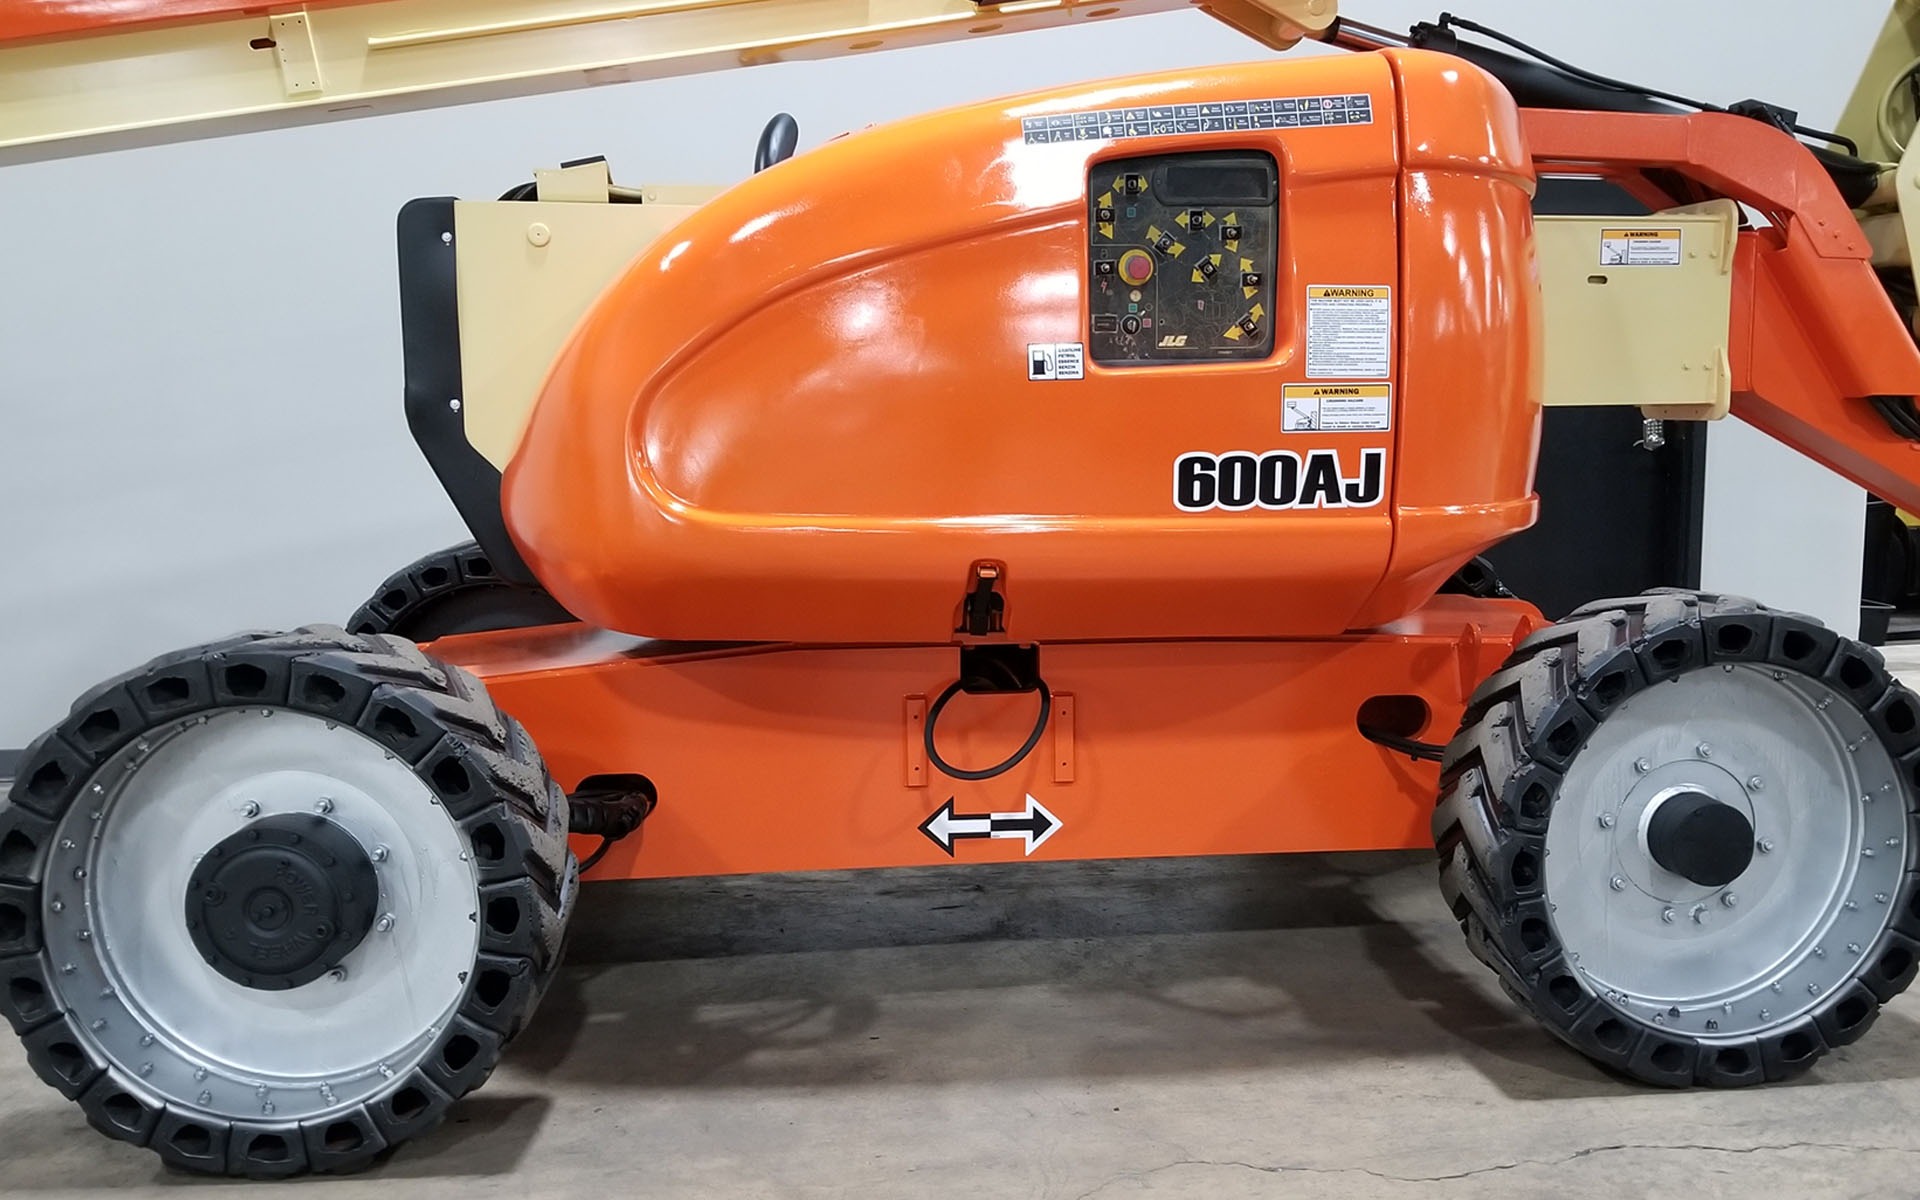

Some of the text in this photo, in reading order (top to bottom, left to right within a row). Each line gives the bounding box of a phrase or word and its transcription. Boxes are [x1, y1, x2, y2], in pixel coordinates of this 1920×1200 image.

[1330, 289, 1374, 297] WARNING
[1158, 335, 1188, 347] JLG
[1175, 450, 1384, 510] 600AJ
